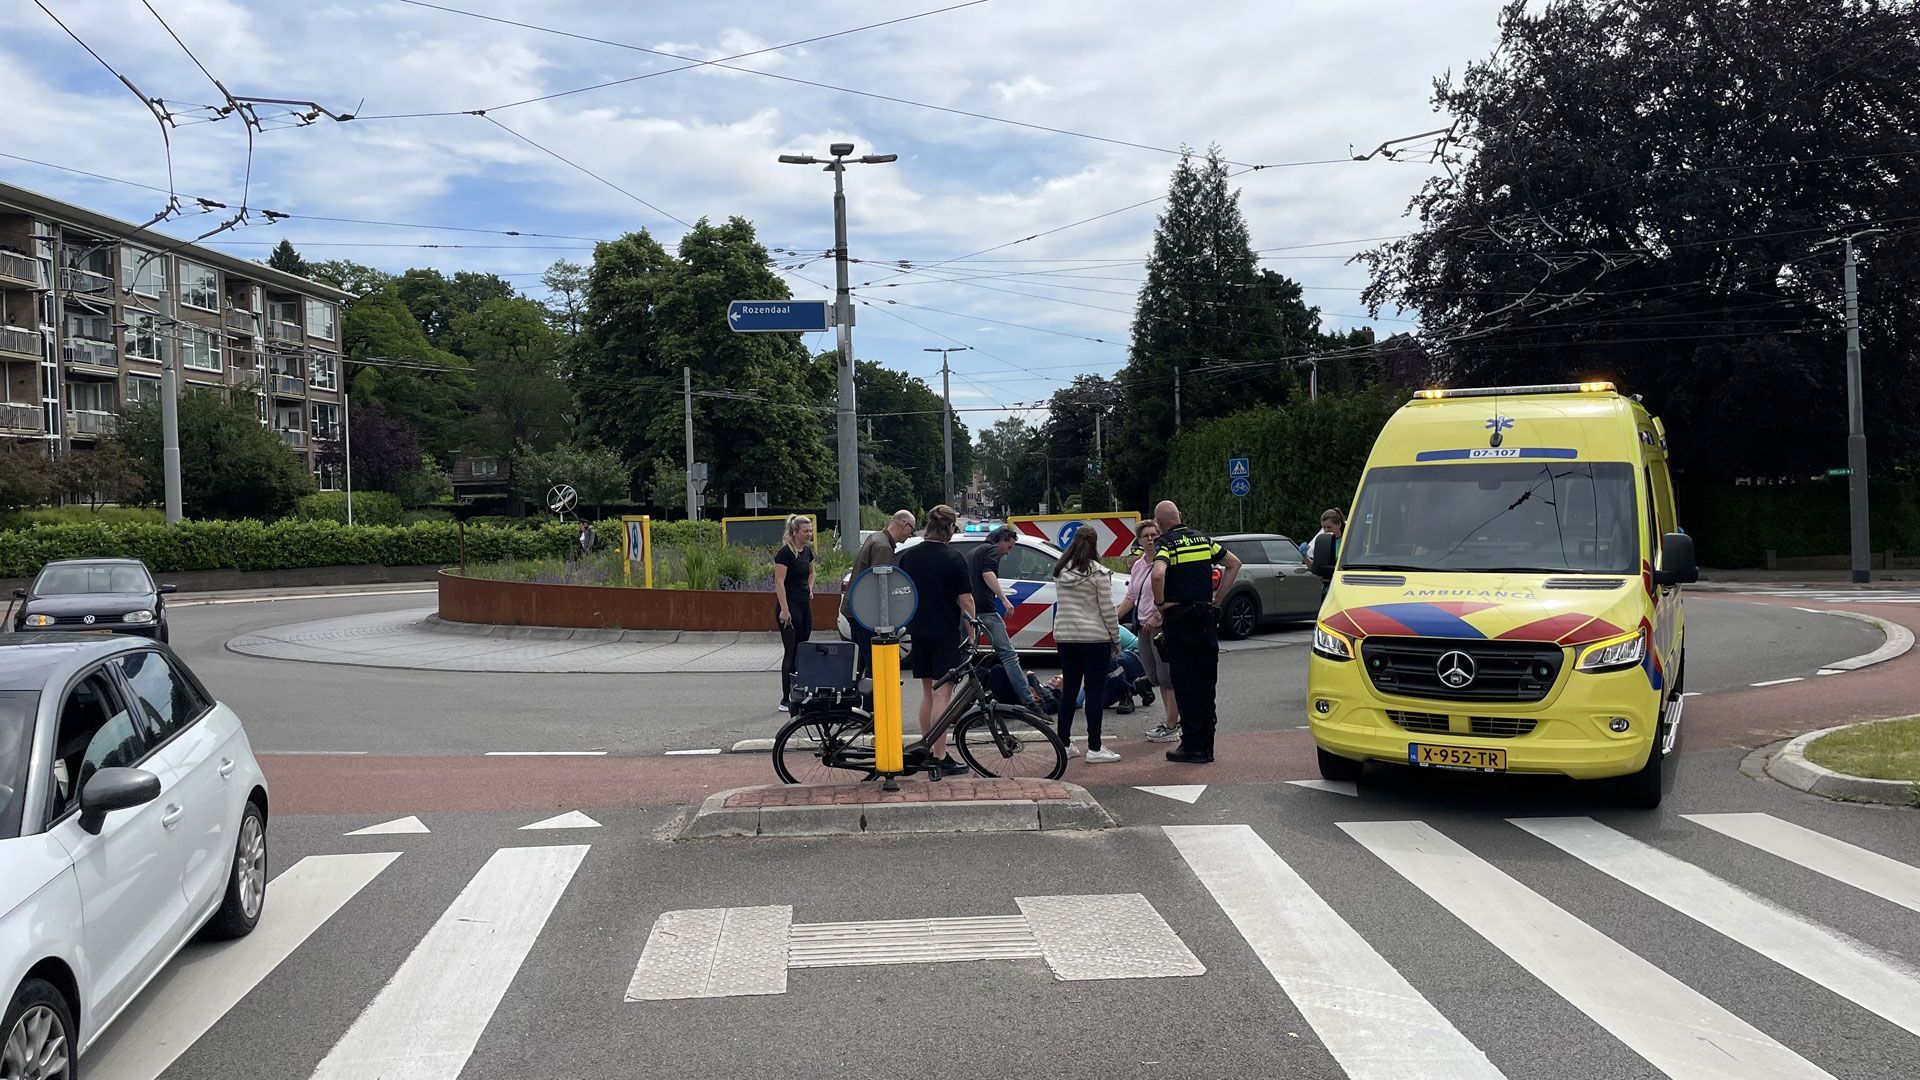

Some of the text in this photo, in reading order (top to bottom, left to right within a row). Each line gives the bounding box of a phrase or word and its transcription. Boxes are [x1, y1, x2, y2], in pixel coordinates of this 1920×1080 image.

[742, 305, 790, 314] Rozendaal
[1473, 449, 1516, 457] 07-107
[1403, 590, 1537, 600] AMBULANCE
[1423, 747, 1498, 767] X-952-TR
